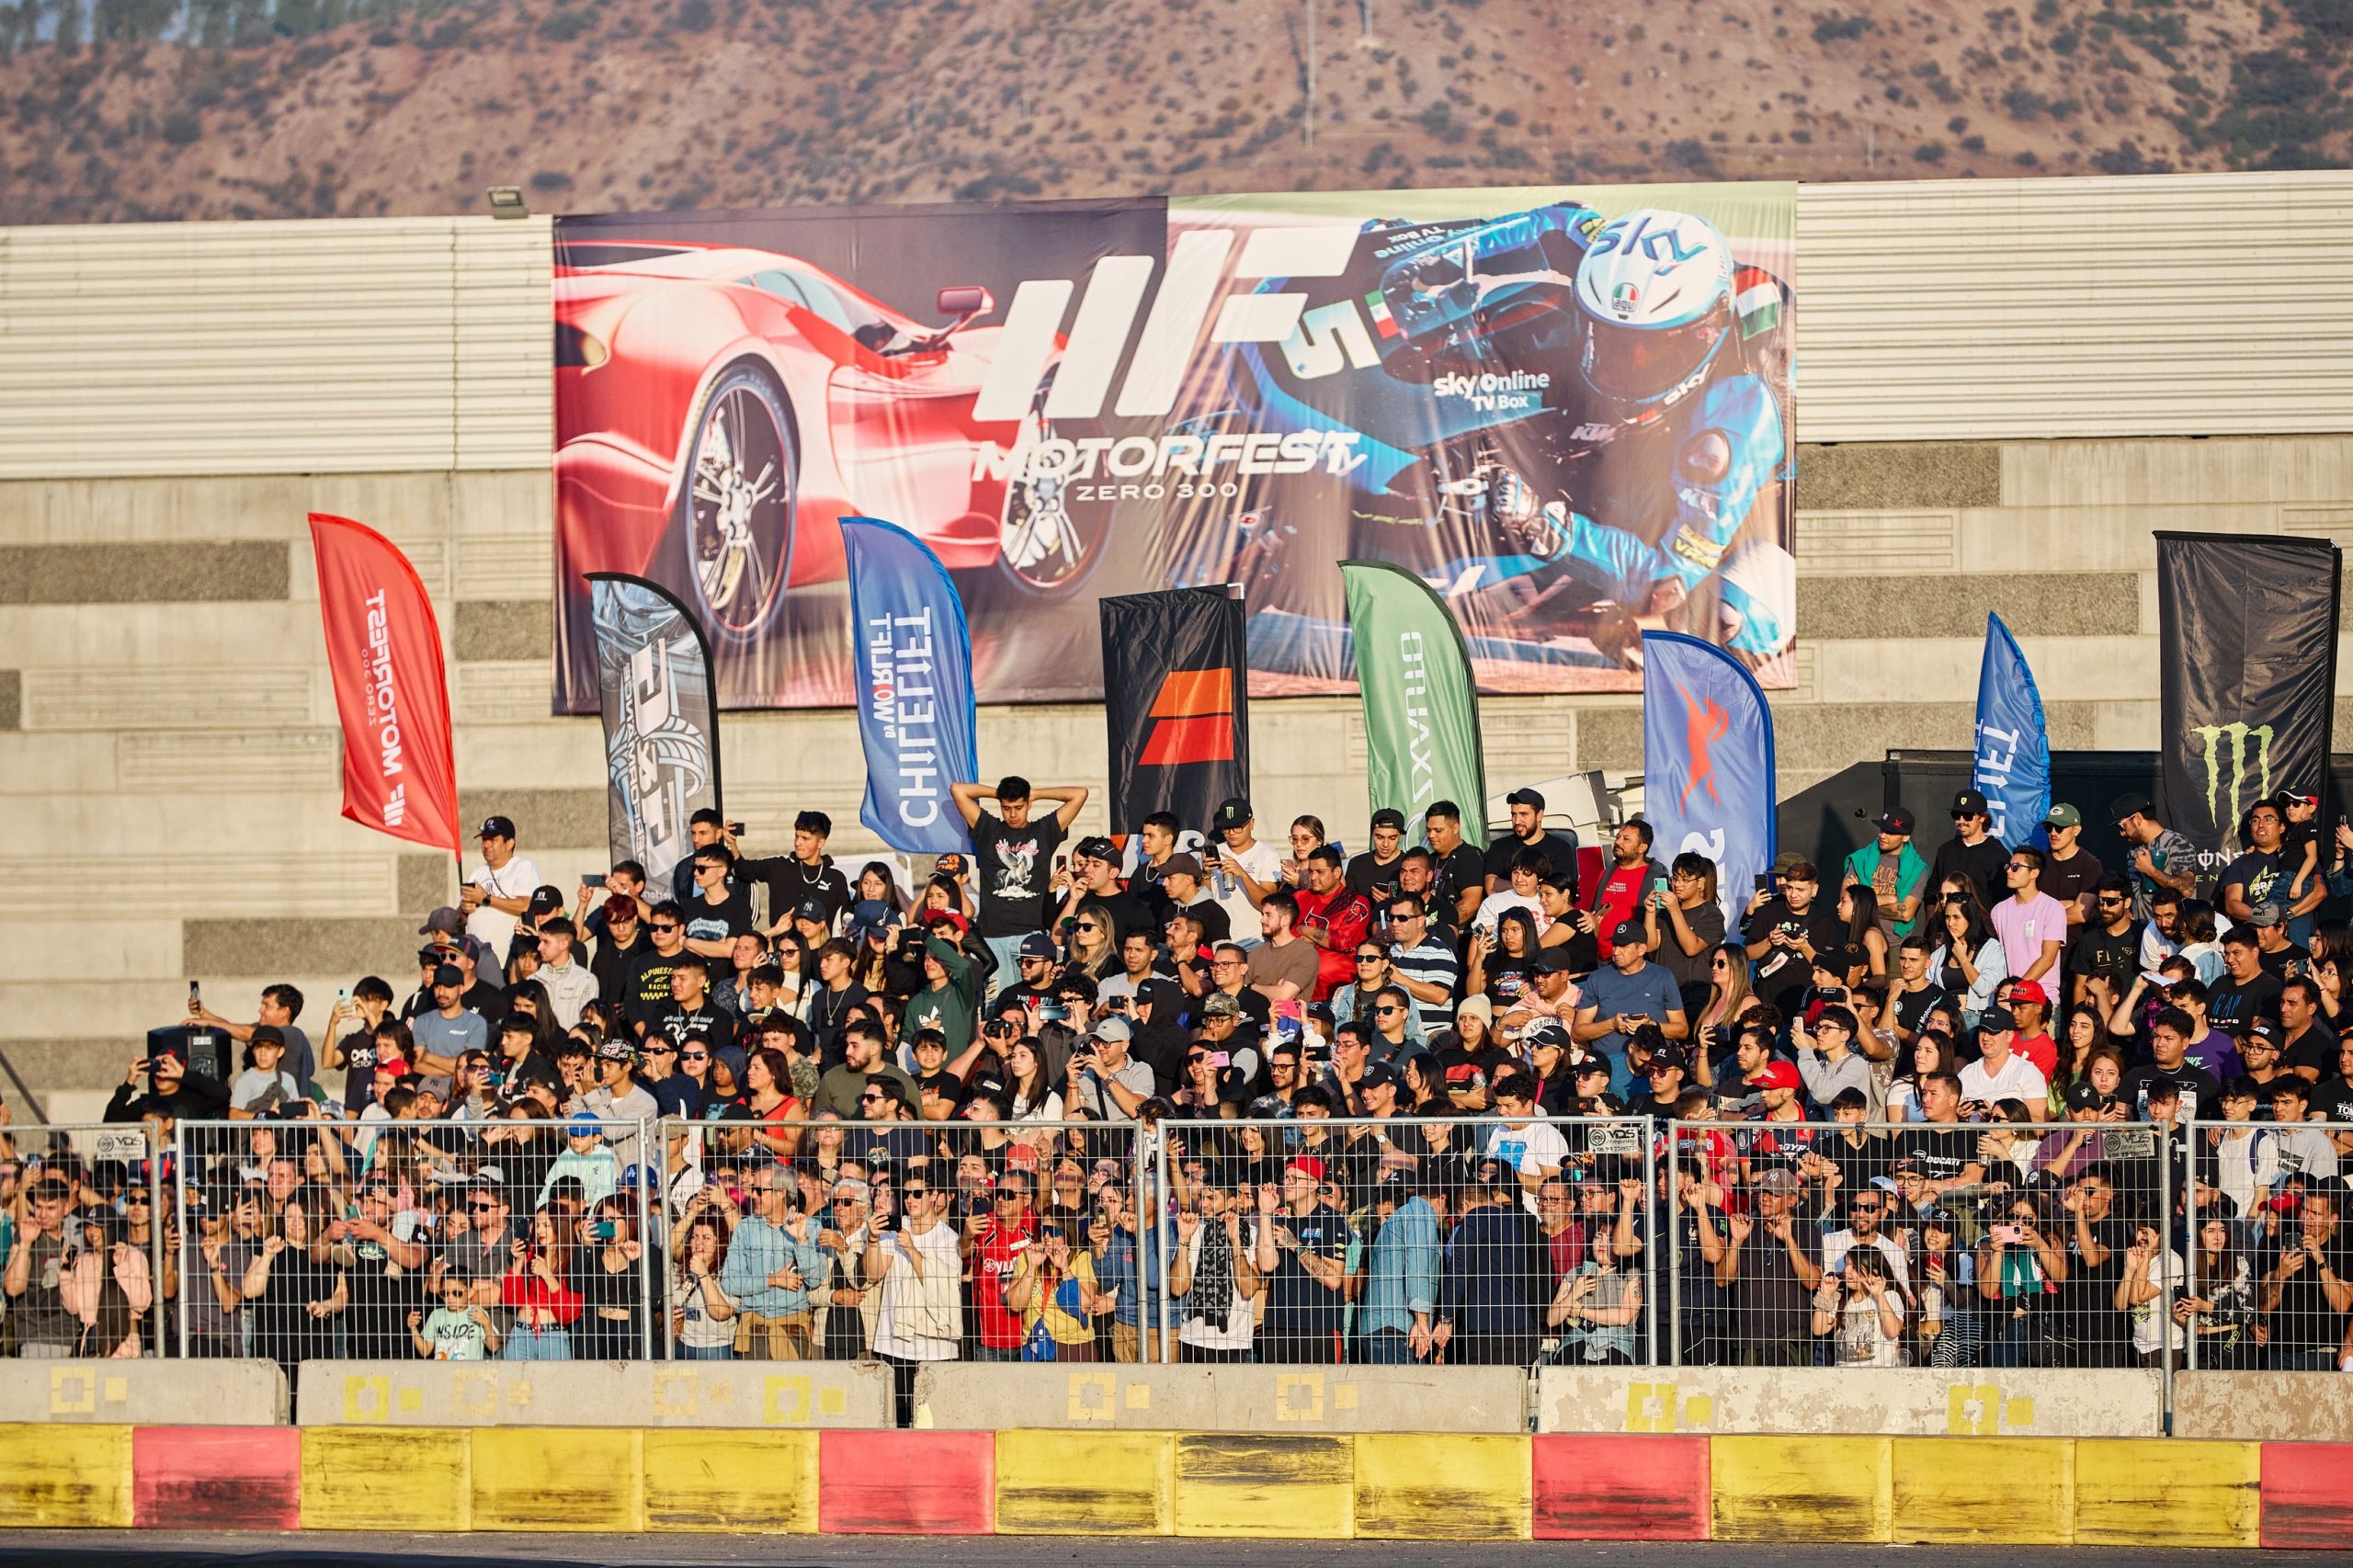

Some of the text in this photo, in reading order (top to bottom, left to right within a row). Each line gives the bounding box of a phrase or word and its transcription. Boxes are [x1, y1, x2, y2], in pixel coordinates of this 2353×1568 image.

[1433, 369, 1551, 400] sky Online
[1471, 394, 1529, 412] TV Box
[972, 432, 1360, 482] MOTORFEST
[1075, 482, 1239, 502] ZERO 300
[1607, 1129, 1635, 1140] VDS
[1926, 1155, 1961, 1166] DUCATI
